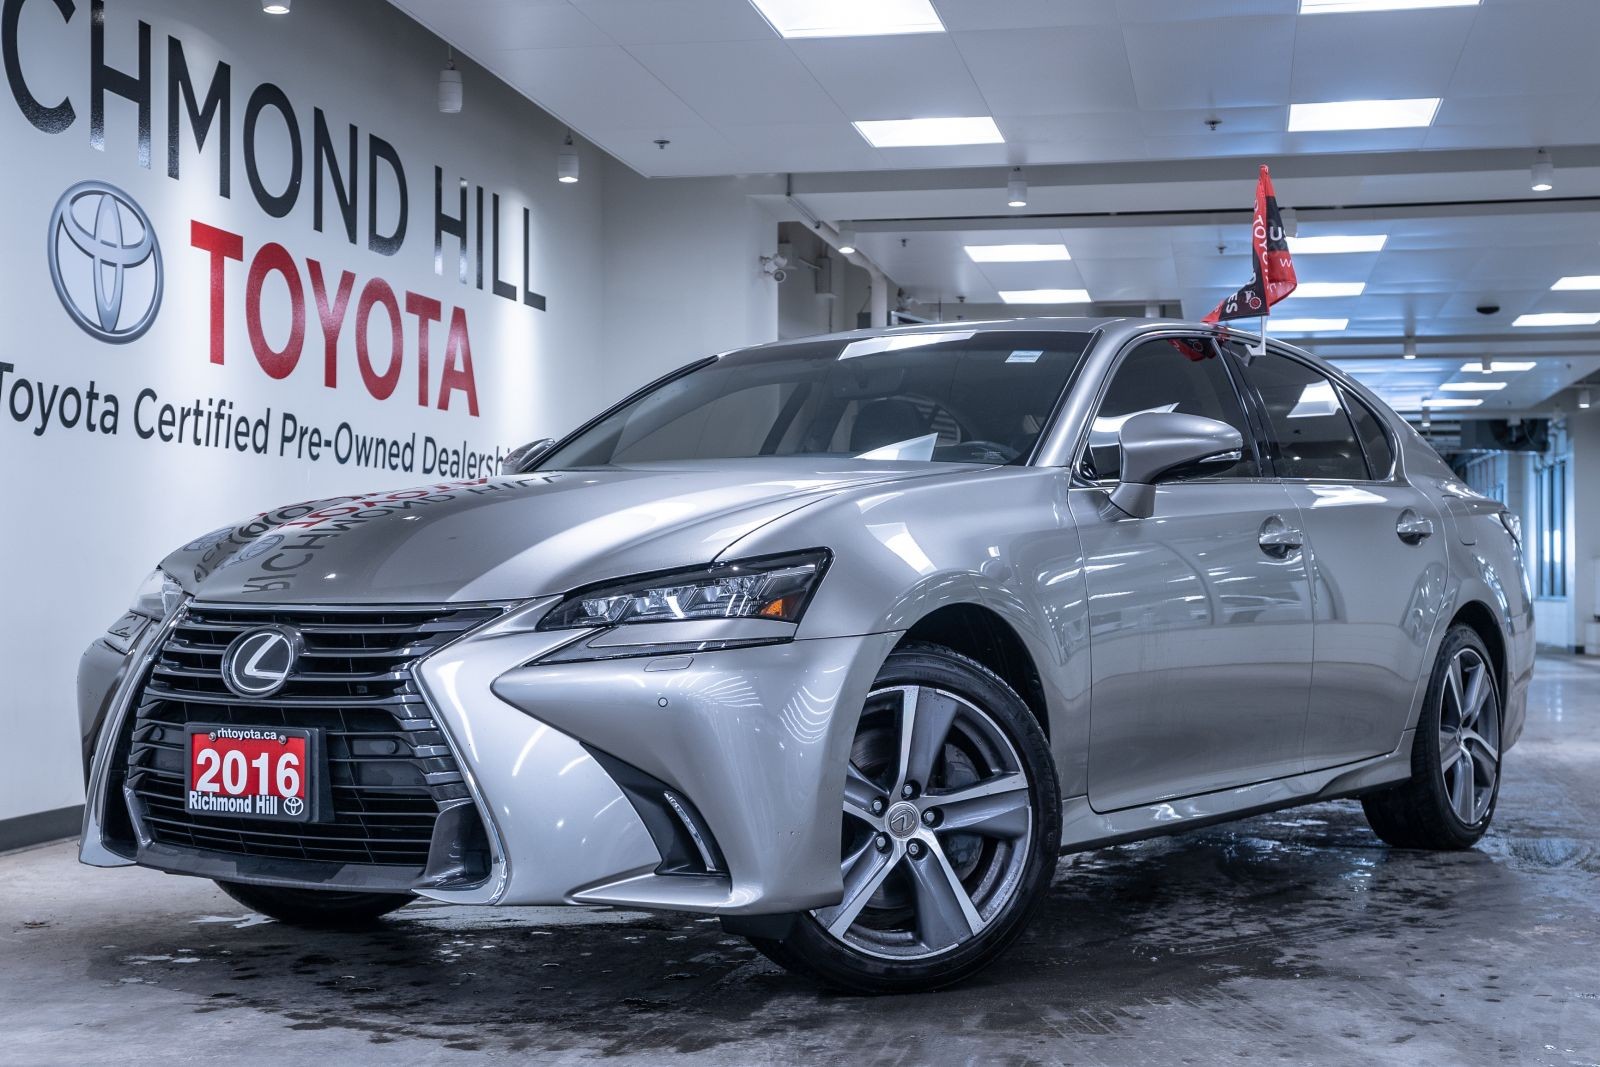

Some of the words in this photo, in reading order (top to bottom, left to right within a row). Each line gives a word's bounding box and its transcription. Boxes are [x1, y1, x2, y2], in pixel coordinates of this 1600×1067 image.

[434, 165, 547, 311] HILL
[190, 219, 480, 417] TOYOTA
[134, 388, 271, 455] Certified
[279, 411, 416, 473] Pre-Owned
[422, 435, 510, 480] Dealersh
[217, 728, 277, 741] rhtoyota.ca
[189, 790, 252, 813] Richmond
[256, 795, 278, 814] Hill
[195, 748, 300, 798] 2016
